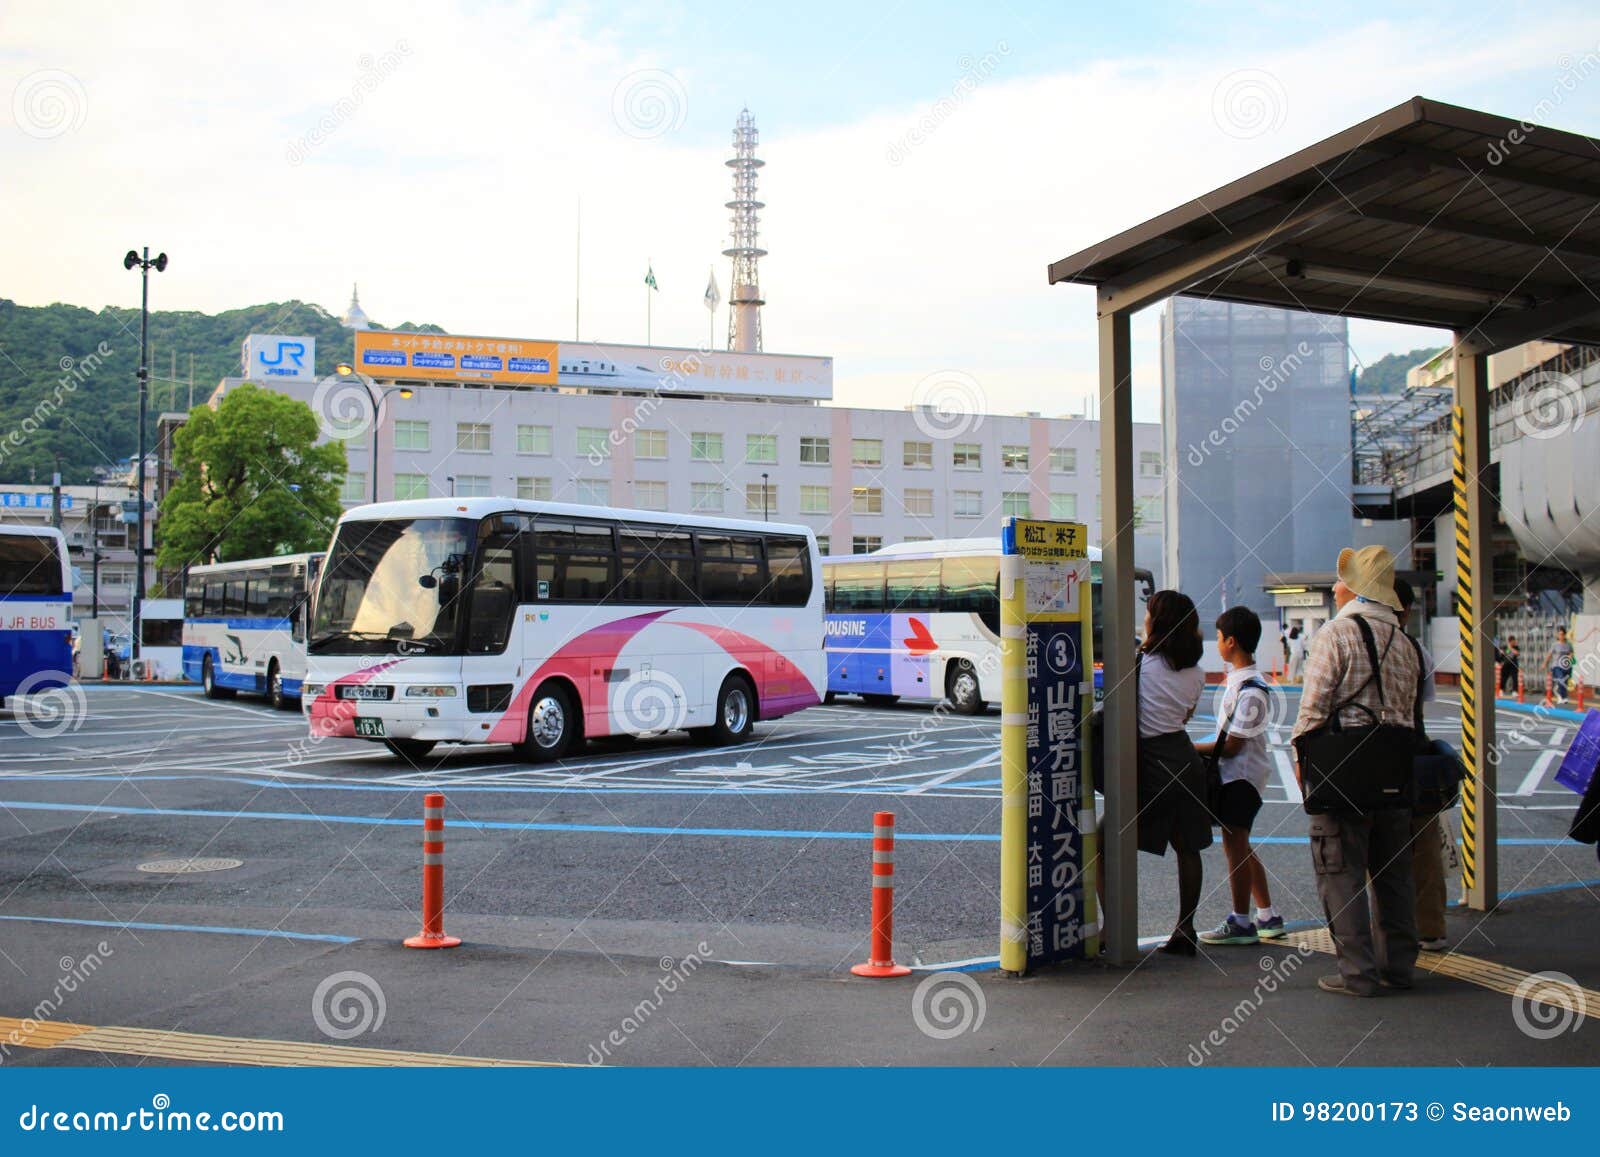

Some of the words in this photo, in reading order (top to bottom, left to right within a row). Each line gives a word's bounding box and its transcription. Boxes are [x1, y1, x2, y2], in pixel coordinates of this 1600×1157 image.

[260, 342, 305, 367] JR
[9, 616, 25, 628] JR
[31, 616, 56, 628] BUS
[1046, 681, 1081, 951] 山陰方面バスのりば
